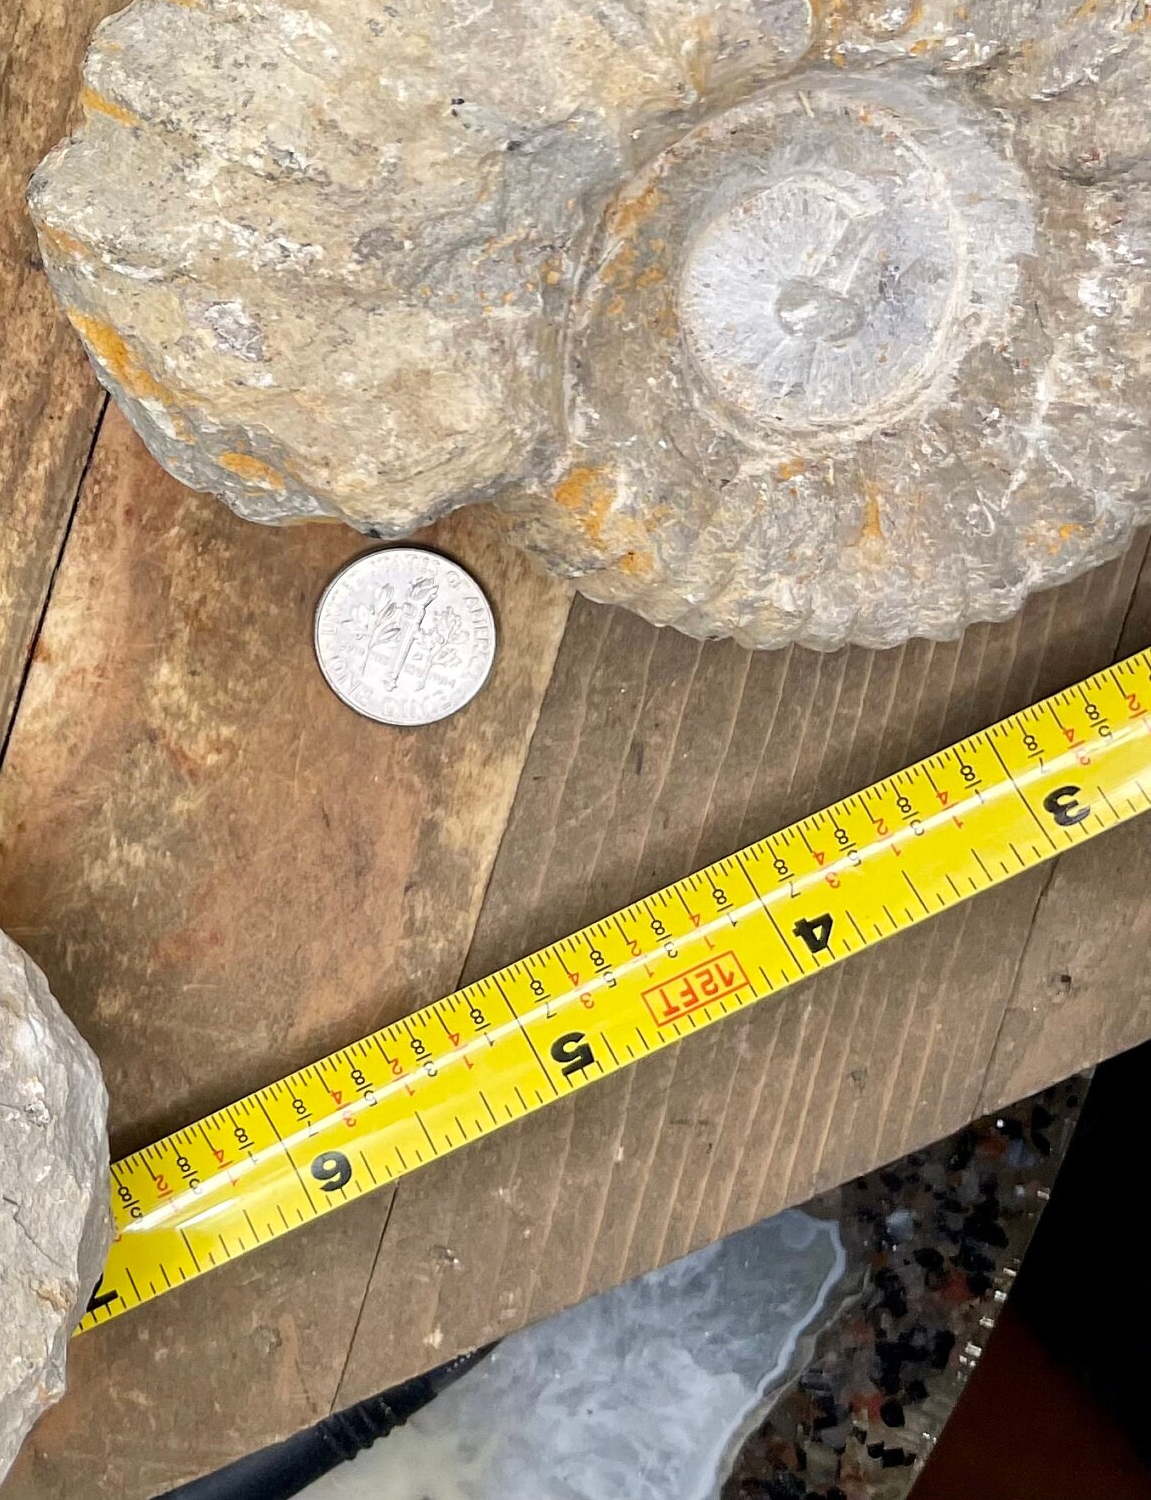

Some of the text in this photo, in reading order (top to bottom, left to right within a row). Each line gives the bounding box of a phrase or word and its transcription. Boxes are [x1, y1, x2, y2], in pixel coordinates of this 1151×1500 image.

[1044, 785, 1091, 826] 3
[792, 913, 834, 953] 4
[660, 962, 736, 1017] 12FT
[550, 1032, 596, 1077] 5
[310, 1151, 353, 1192] 6
